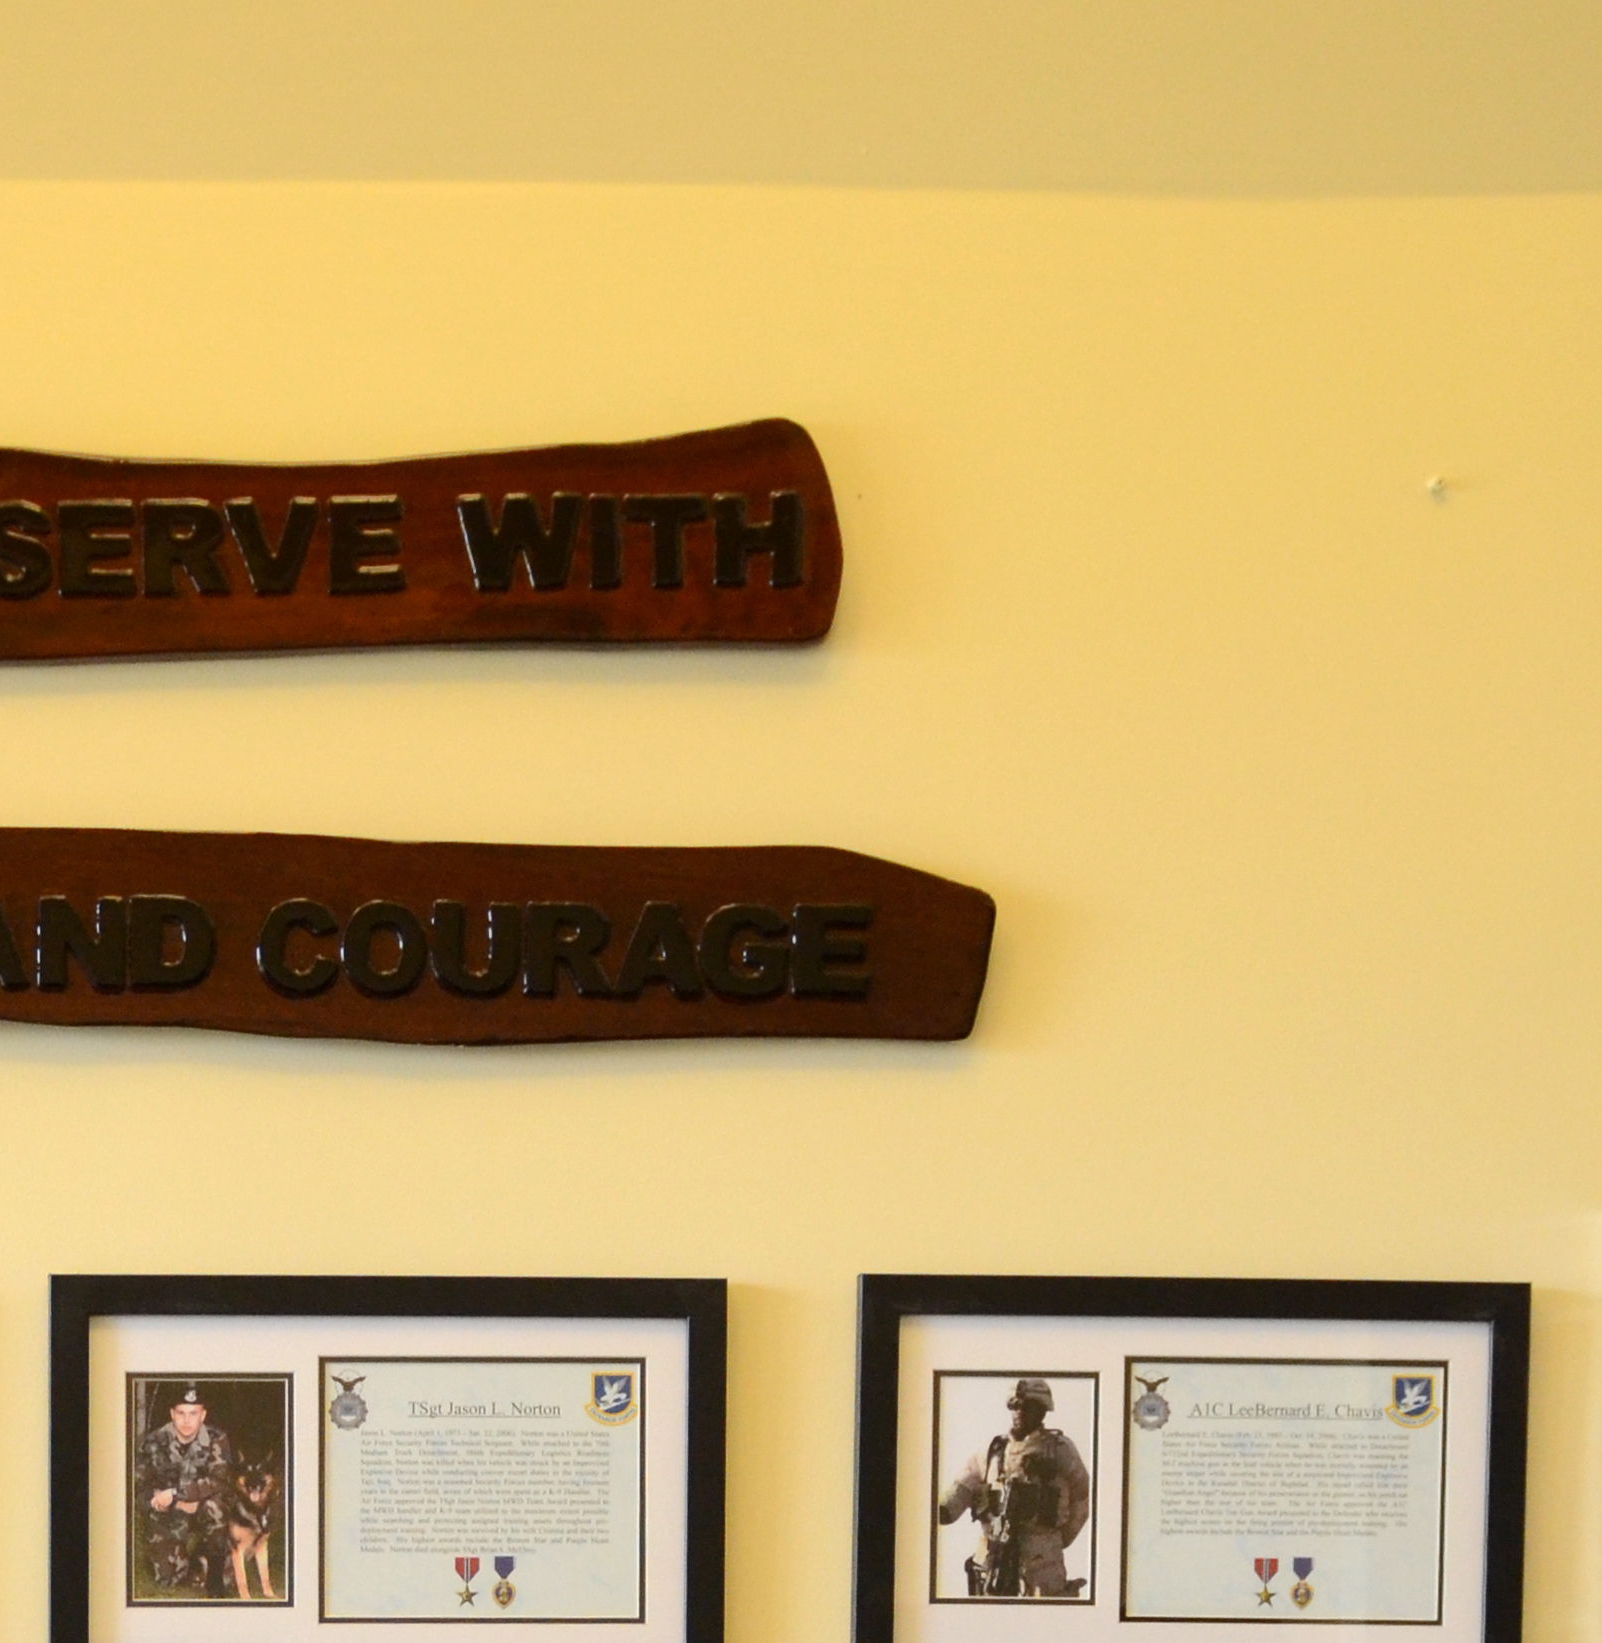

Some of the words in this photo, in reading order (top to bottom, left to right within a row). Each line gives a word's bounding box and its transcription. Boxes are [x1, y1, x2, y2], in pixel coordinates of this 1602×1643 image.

[455, 490, 806, 592] WITH
[256, 898, 874, 1000] COURAGE
[409, 1402, 443, 1418] TSgt
[448, 1403, 486, 1416] Jason
[512, 1402, 560, 1416] Norton
[1191, 1404, 1223, 1416] A1C
[1229, 1403, 1311, 1417] LeeBernard
[1335, 1404, 1384, 1418] Chavis
